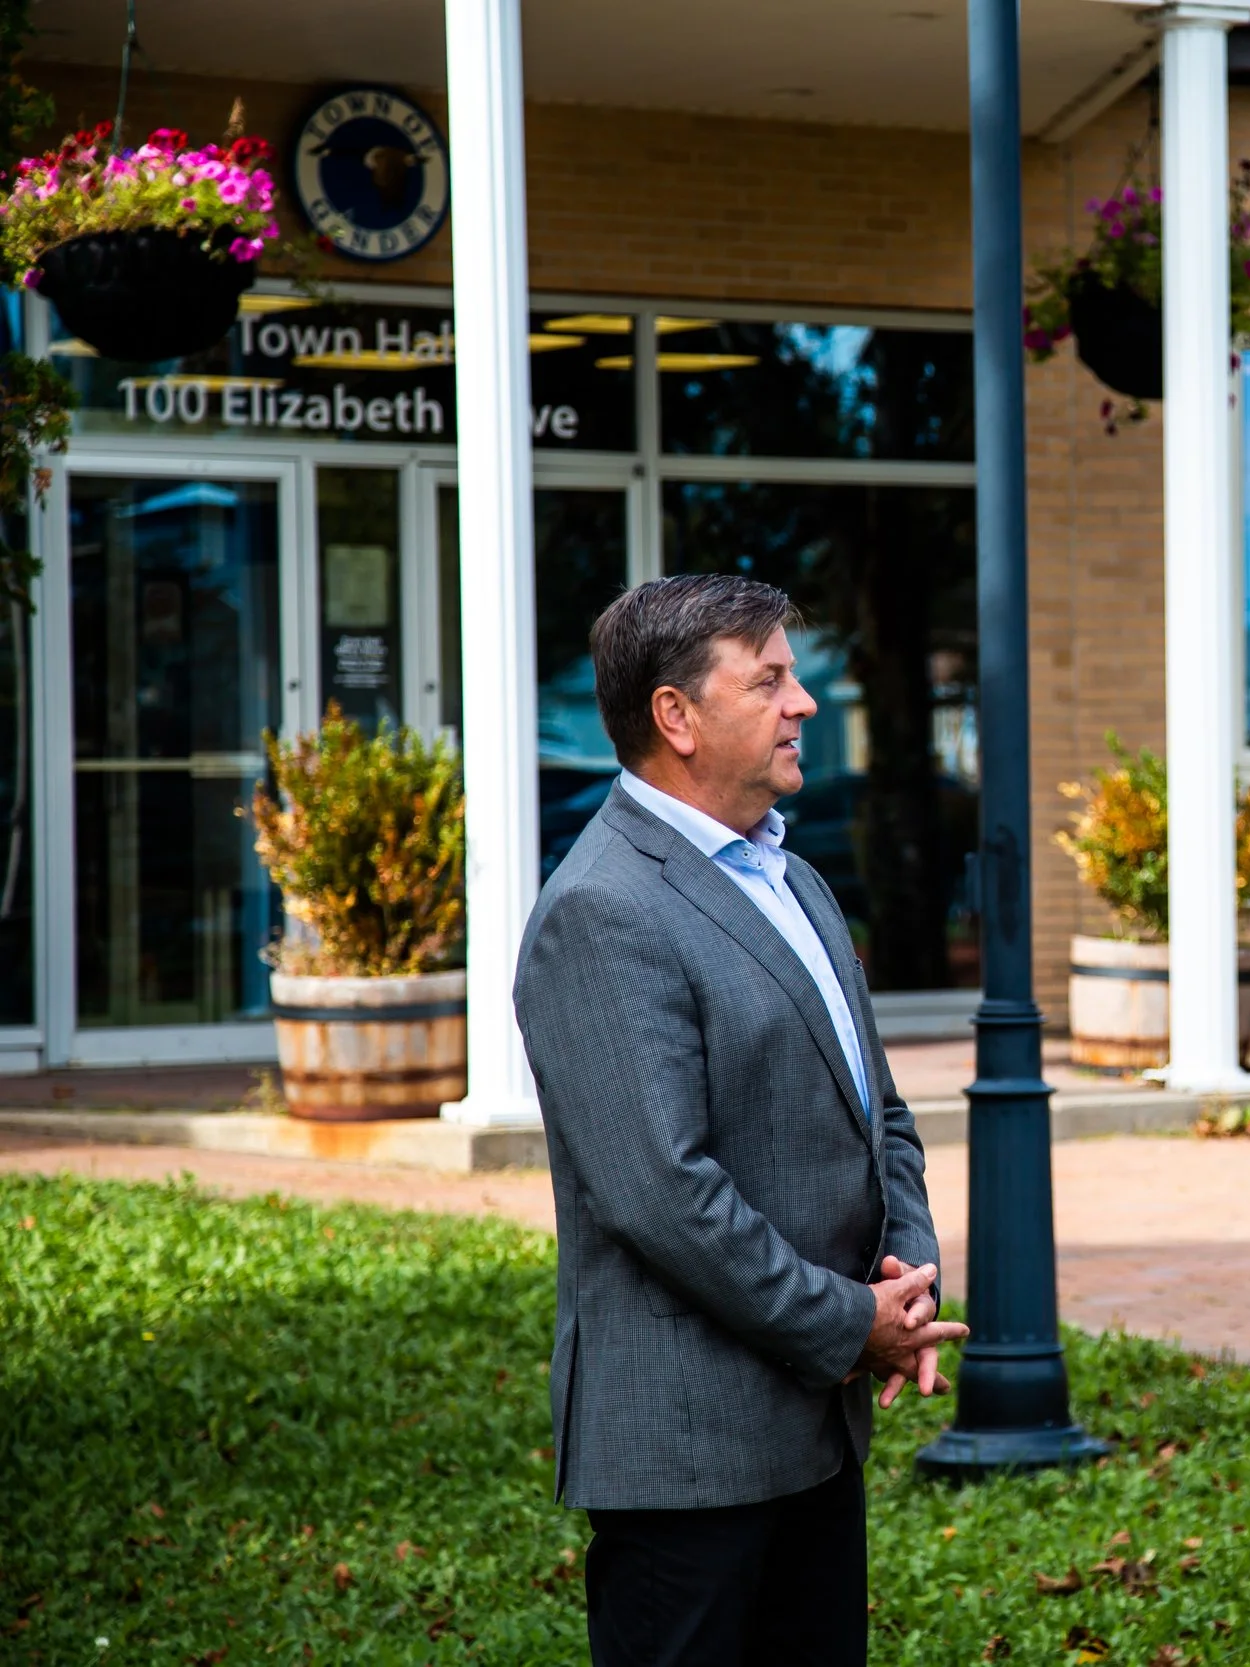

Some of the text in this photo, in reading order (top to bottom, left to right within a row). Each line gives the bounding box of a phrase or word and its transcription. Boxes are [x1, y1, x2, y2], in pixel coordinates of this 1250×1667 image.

[236, 314, 361, 357] Town
[117, 377, 208, 424] 100
[221, 382, 444, 434] Elizabeth
